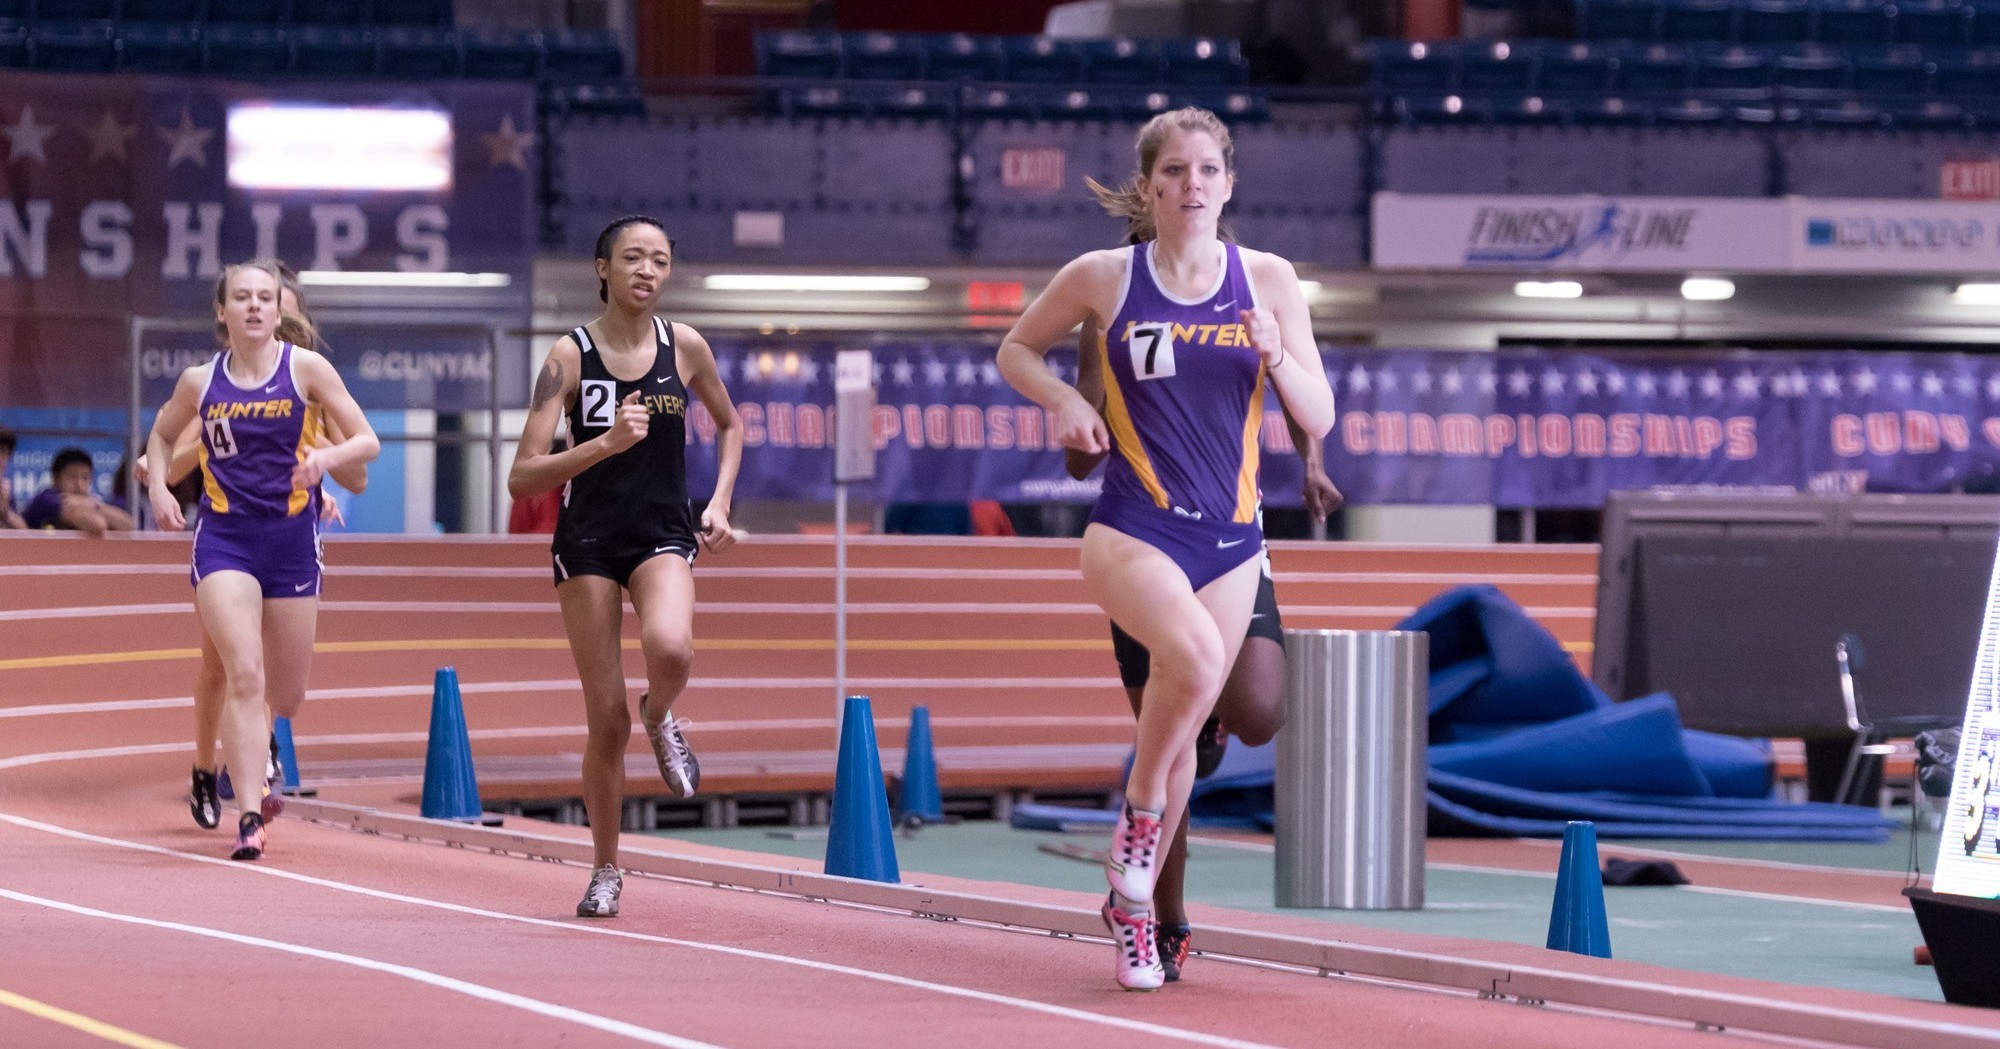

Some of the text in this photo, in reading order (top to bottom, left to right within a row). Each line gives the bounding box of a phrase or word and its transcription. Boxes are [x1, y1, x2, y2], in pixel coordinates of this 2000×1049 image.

[1466, 205, 1698, 252] FINISH LINE
[1121, 320, 1251, 347] NTER
[1134, 327, 1165, 376] 7
[206, 398, 293, 421] HUNTER
[584, 383, 610, 423] 2
[643, 393, 686, 418] EVERS
[213, 423, 231, 454] 4
[1342, 409, 1758, 461] CHAMPIONSHIPS
[1830, 408, 1971, 458] CUNY
